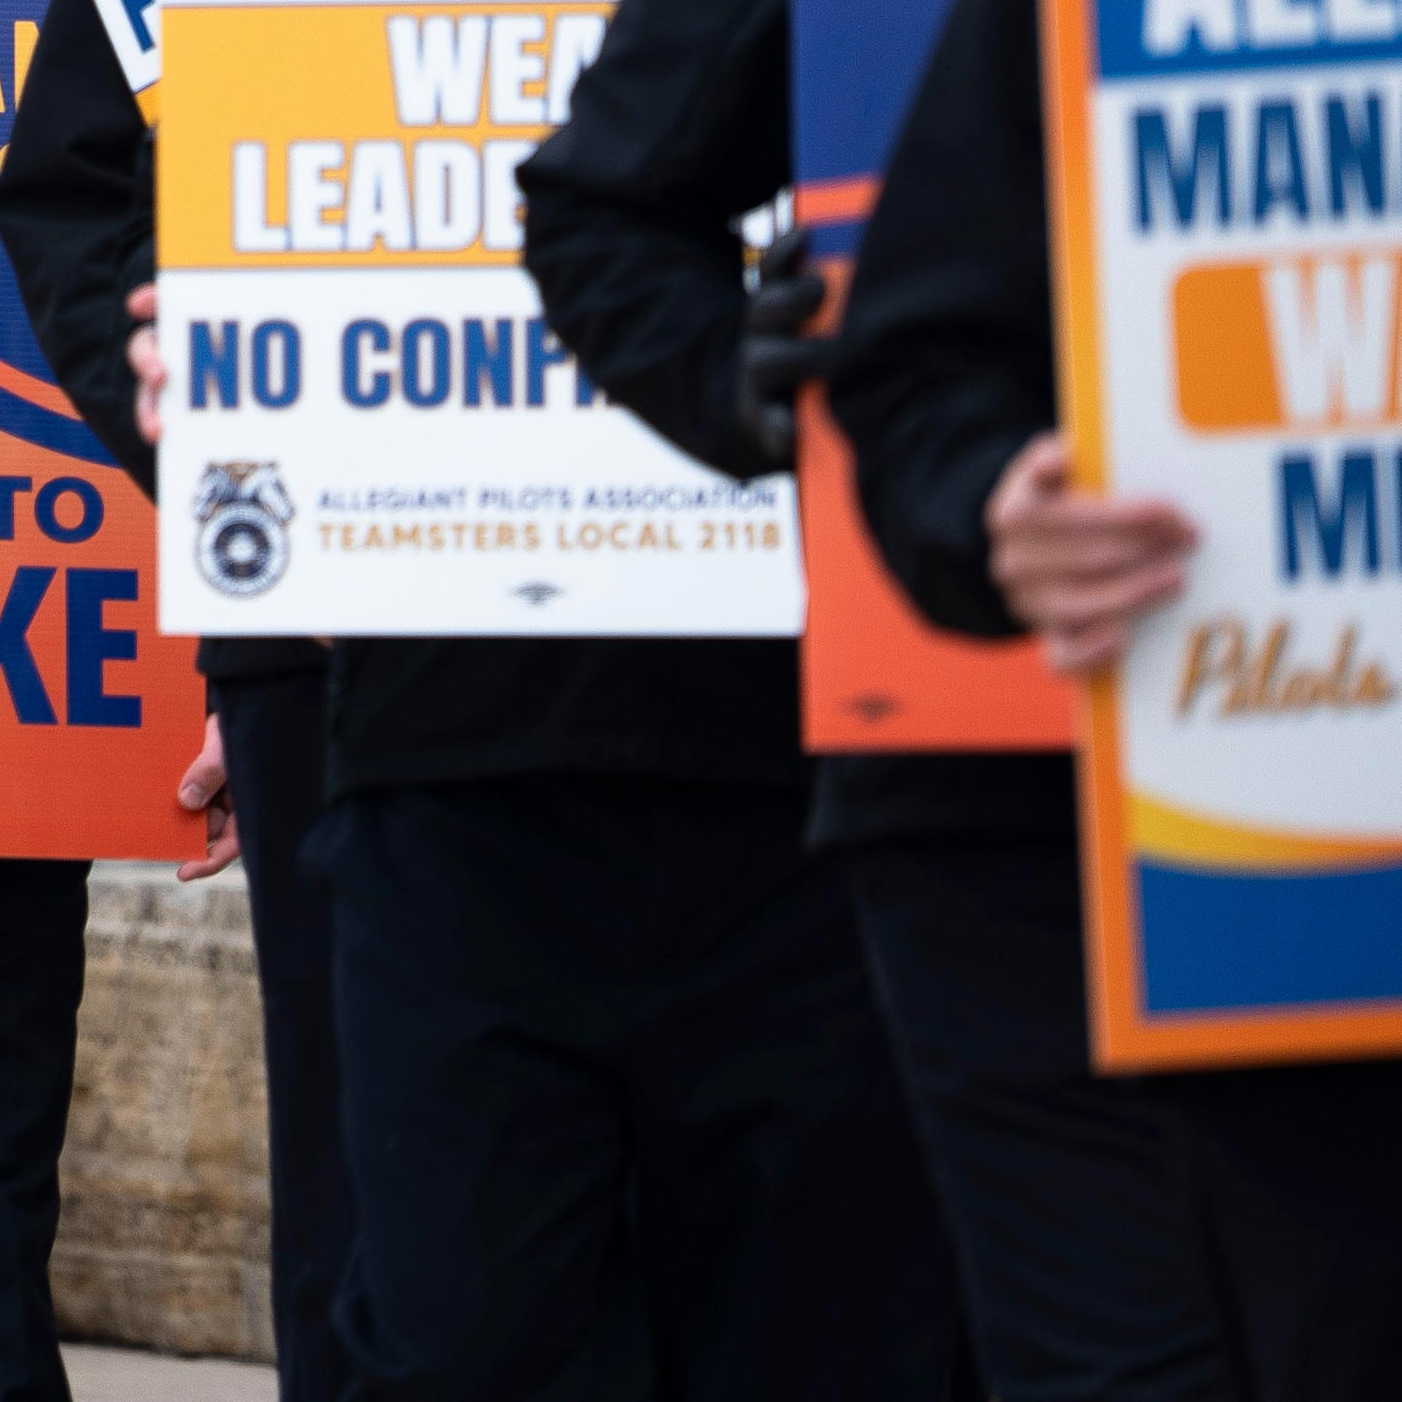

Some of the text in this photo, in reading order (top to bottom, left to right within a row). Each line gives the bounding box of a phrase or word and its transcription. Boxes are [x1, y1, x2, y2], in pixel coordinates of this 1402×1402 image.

[386, 13, 607, 127] WEA
[231, 138, 538, 253] LEADE
[1132, 86, 1396, 239] MAN
[187, 317, 303, 410] NO
[317, 521, 784, 553] TEAMSTERS LOCAL 2118
